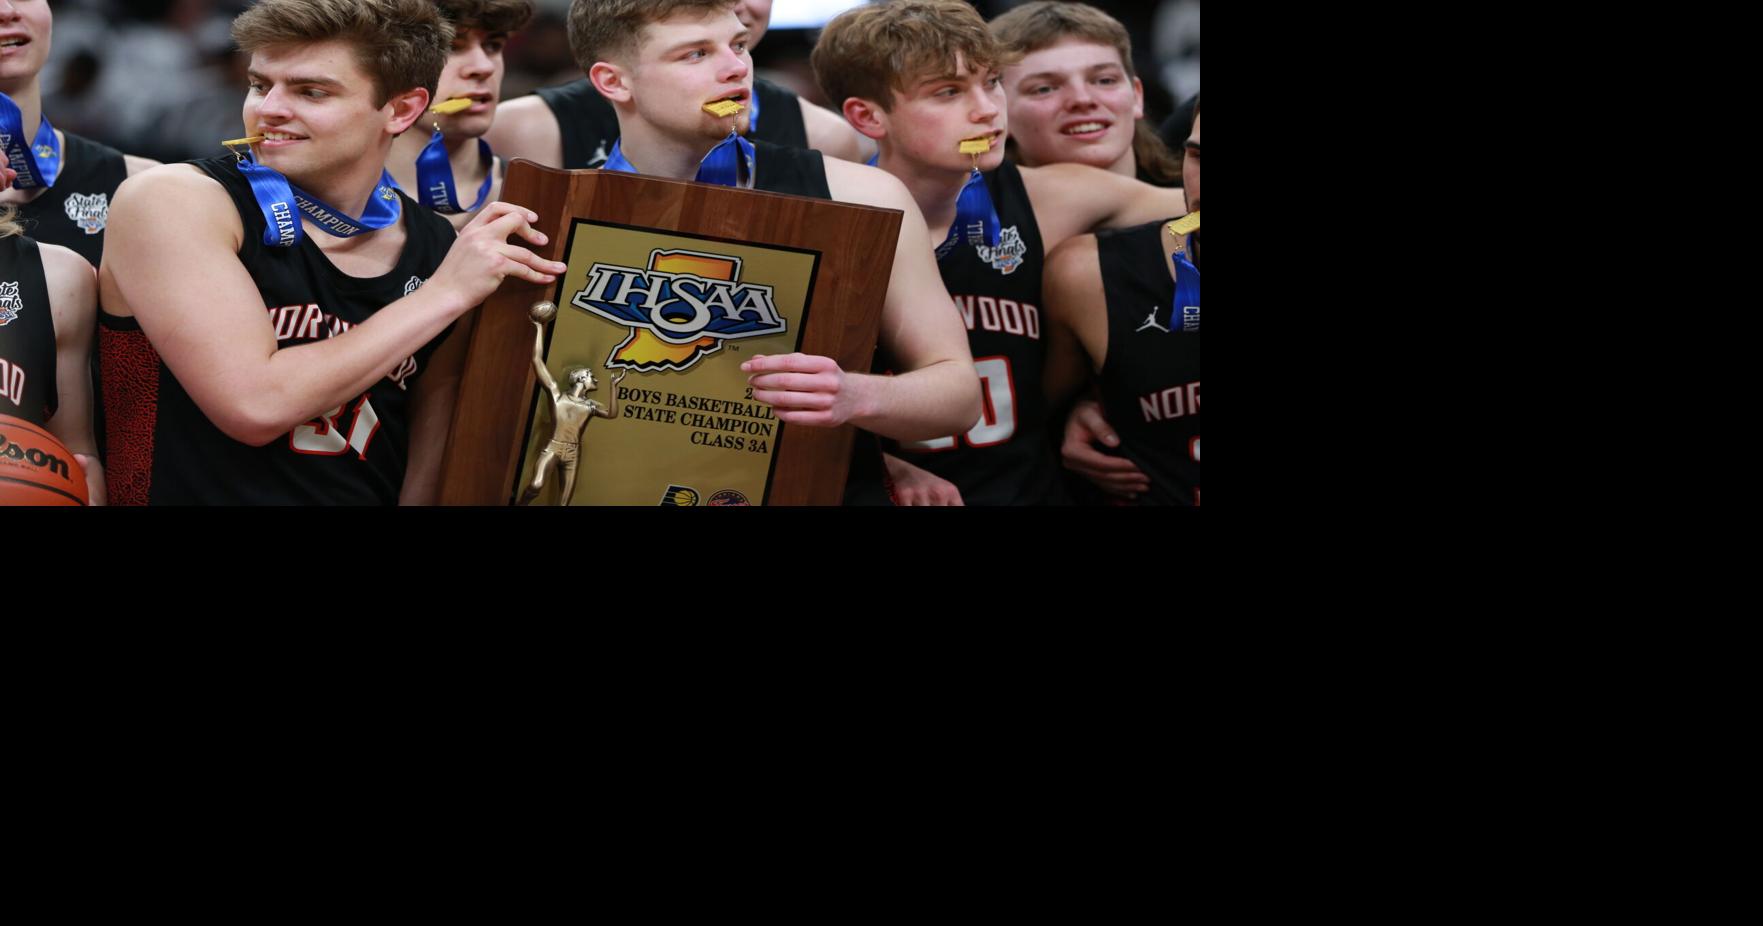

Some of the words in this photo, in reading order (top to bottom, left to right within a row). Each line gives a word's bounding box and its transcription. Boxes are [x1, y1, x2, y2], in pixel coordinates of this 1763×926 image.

[295, 195, 360, 235] CHAMPION
[579, 266, 782, 333] IHSAA
[618, 387, 662, 406] BOYS
[665, 393, 776, 420] BASKETBALL
[624, 404, 677, 424] STATE
[680, 413, 774, 437] CHAMPION
[690, 431, 745, 450] CLASS
[748, 439, 768, 454] 3A
